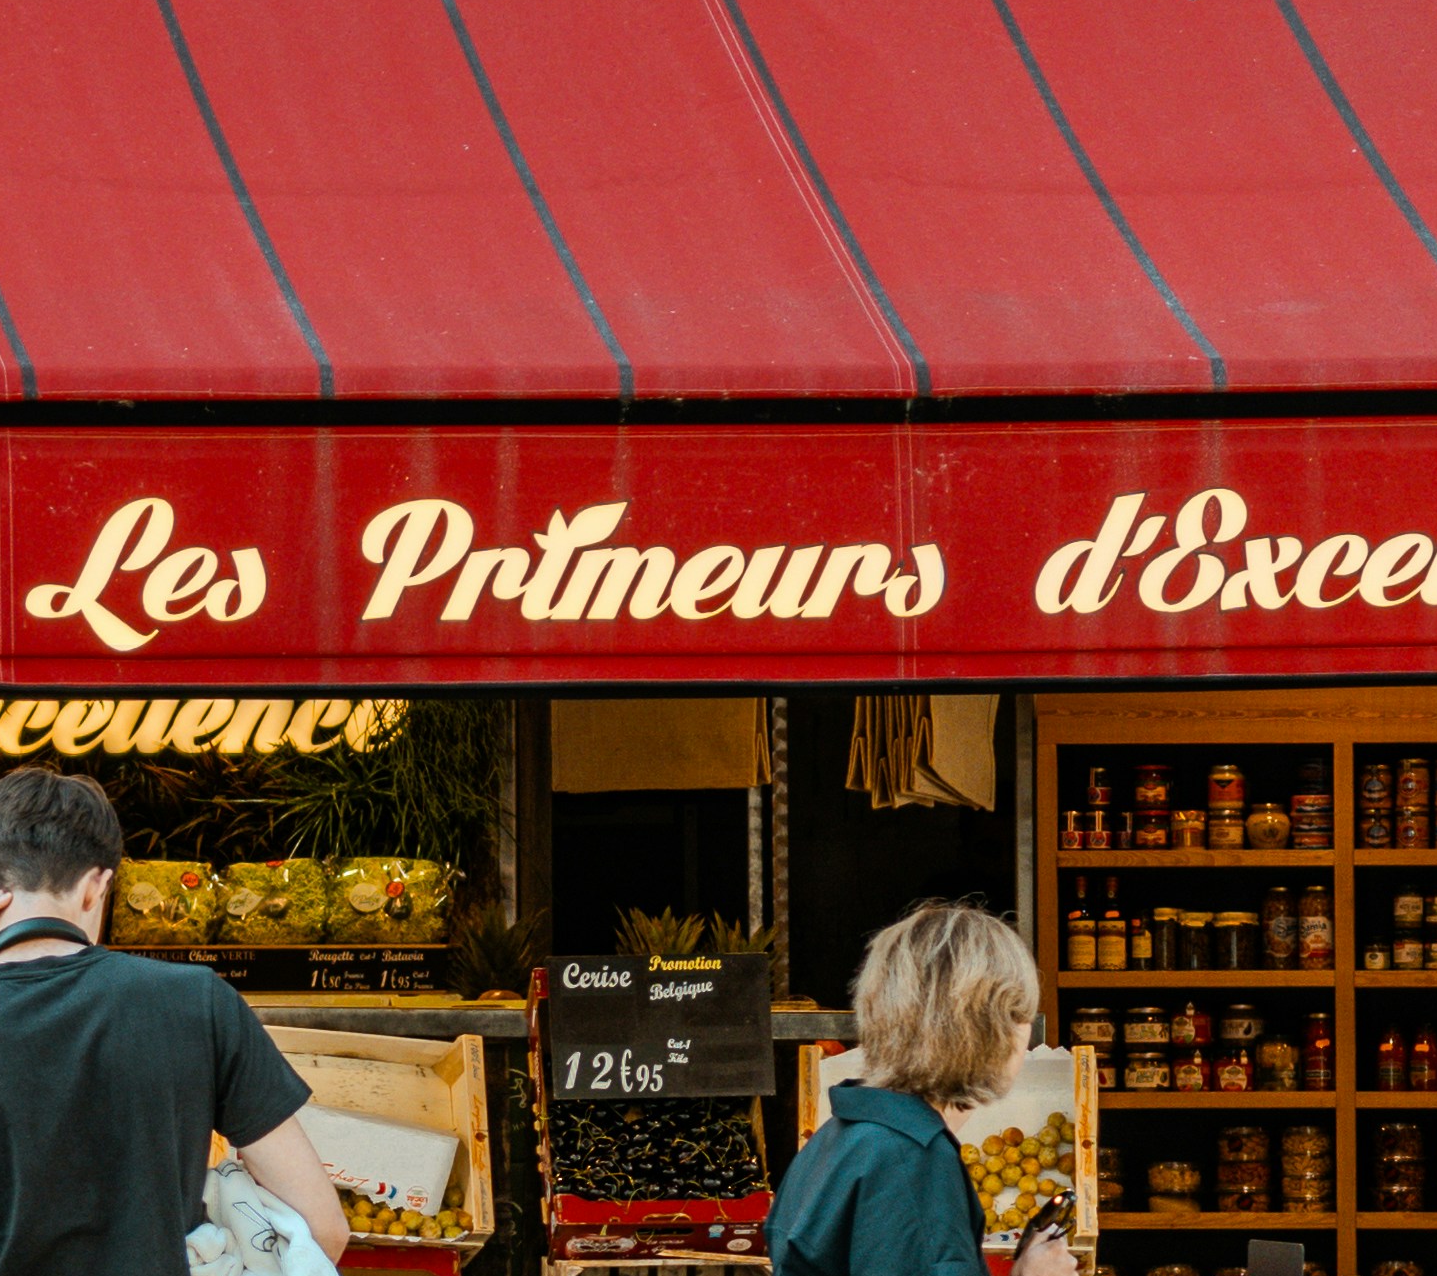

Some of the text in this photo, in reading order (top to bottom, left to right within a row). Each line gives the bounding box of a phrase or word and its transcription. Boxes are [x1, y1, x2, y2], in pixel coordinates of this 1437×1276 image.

[25, 497, 267, 651] Les
[362, 499, 945, 621] Primeurs
[221, 951, 256, 961] VERTE
[308, 950, 354, 964] Rougette
[381, 950, 424, 962] Batavia
[649, 955, 721, 971] Promotion
[562, 963, 714, 1002] Cerise Belgique
